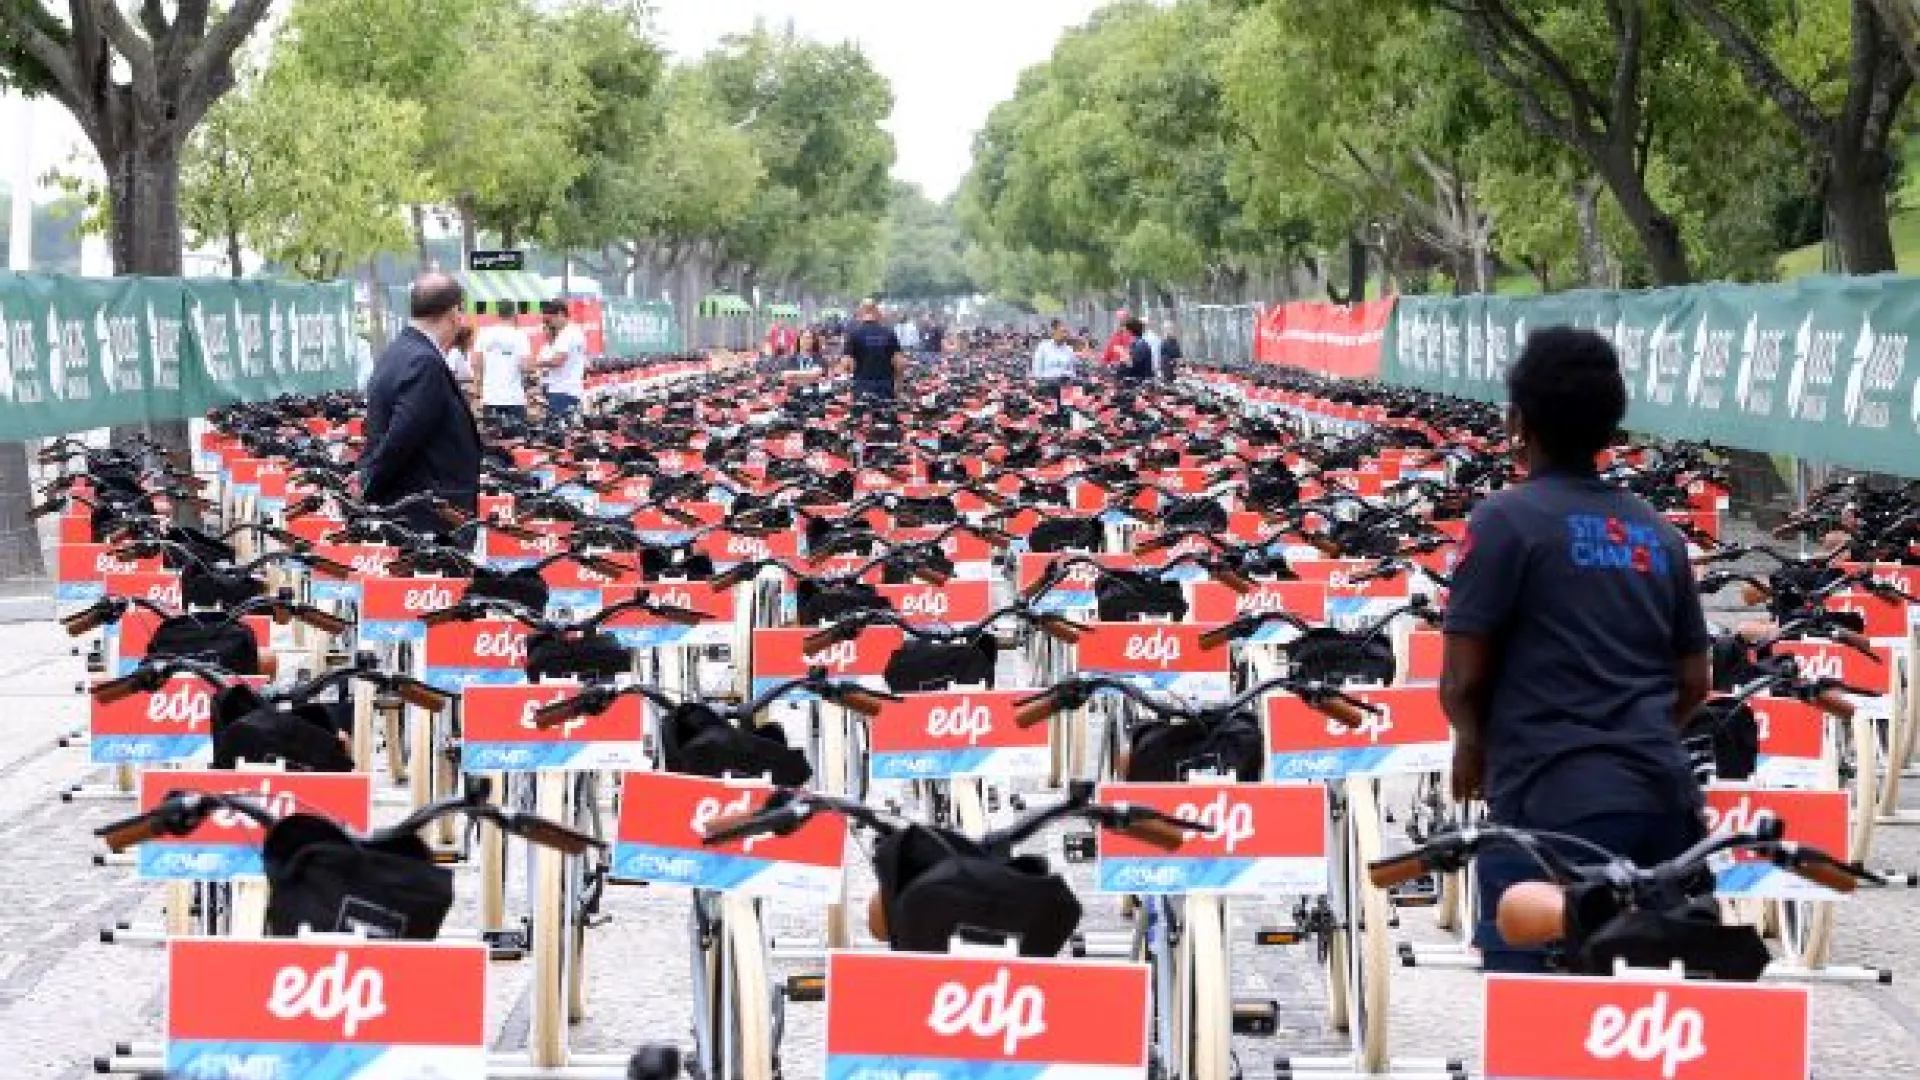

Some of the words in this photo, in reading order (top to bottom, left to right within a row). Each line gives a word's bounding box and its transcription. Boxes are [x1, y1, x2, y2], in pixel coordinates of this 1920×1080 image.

[475, 628, 527, 666] edp
[1125, 628, 1181, 667] edp
[148, 685, 211, 729] edp
[927, 698, 991, 746] edp
[267, 951, 388, 1038] edp
[927, 967, 1048, 1056] edp
[1584, 991, 1706, 1079] edp
